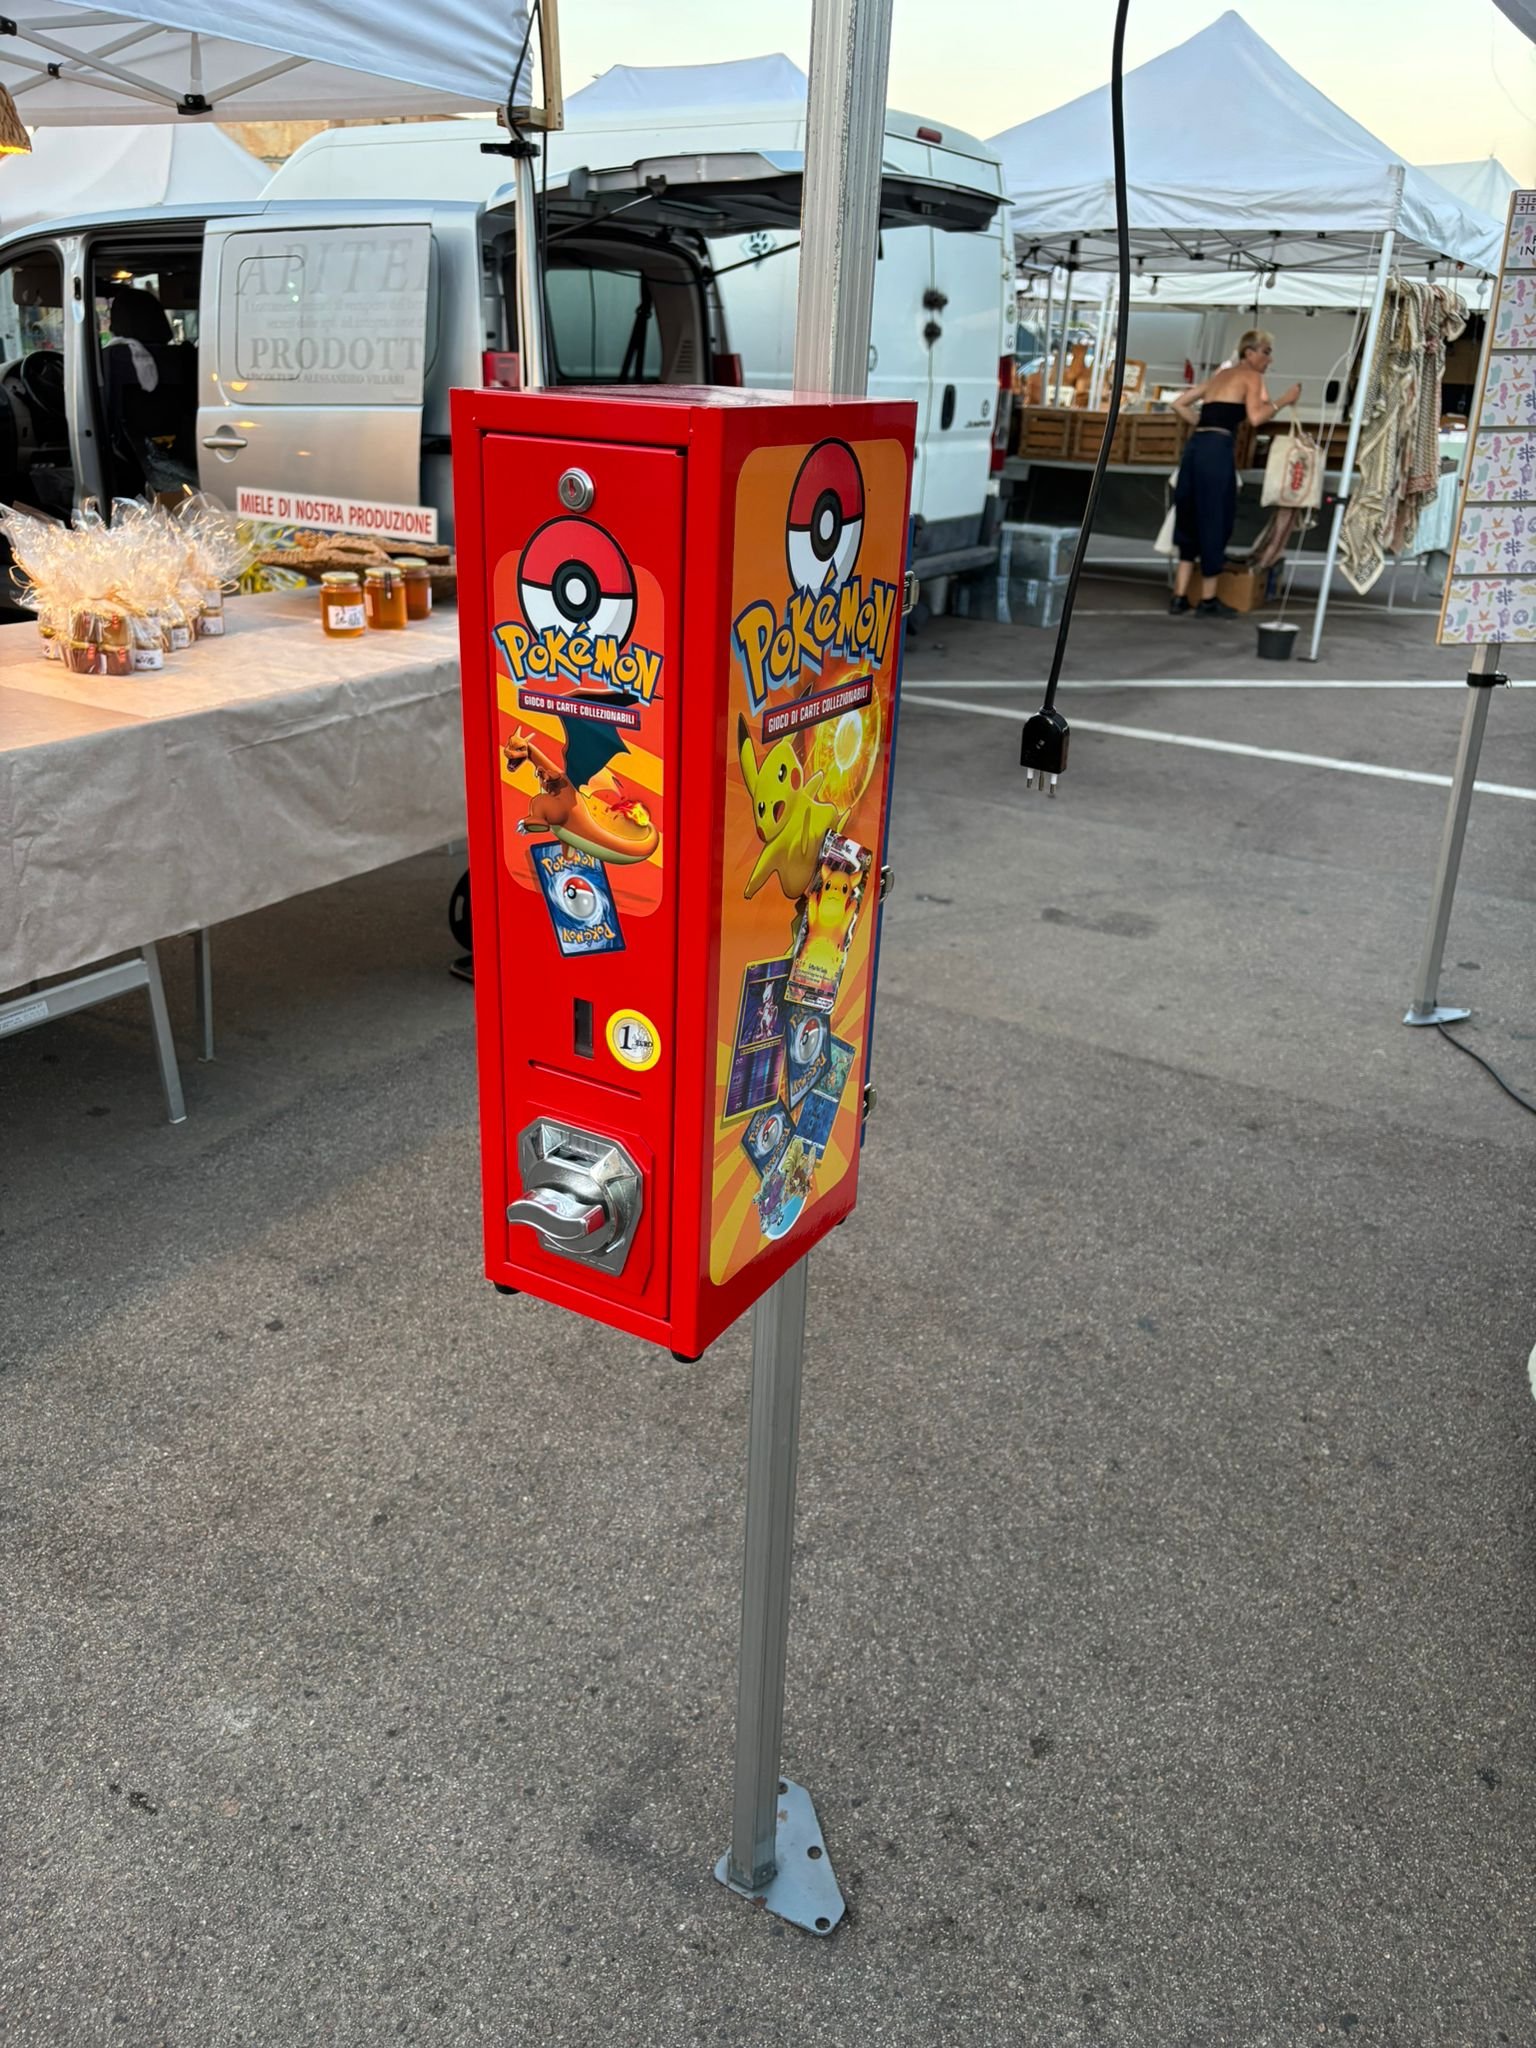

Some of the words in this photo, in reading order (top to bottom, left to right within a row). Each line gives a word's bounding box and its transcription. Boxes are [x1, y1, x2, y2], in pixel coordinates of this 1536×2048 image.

[233, 239, 428, 297] APITE
[240, 493, 274, 516] MIELE
[278, 498, 291, 518] DI
[295, 501, 344, 524] NOSTRA
[349, 506, 432, 535] PRODUZIONE
[524, 695, 545, 708] GIOCO
[546, 699, 554, 710] DI
[556, 702, 578, 714] CARTE
[579, 705, 635, 725] COLLEZIONABILI
[768, 713, 789, 733] GIOCO
[790, 710, 799, 725] DI
[800, 702, 820, 721] CARTE
[821, 685, 868, 713] COLLEZIONABILI
[620, 1025, 633, 1050] 1
